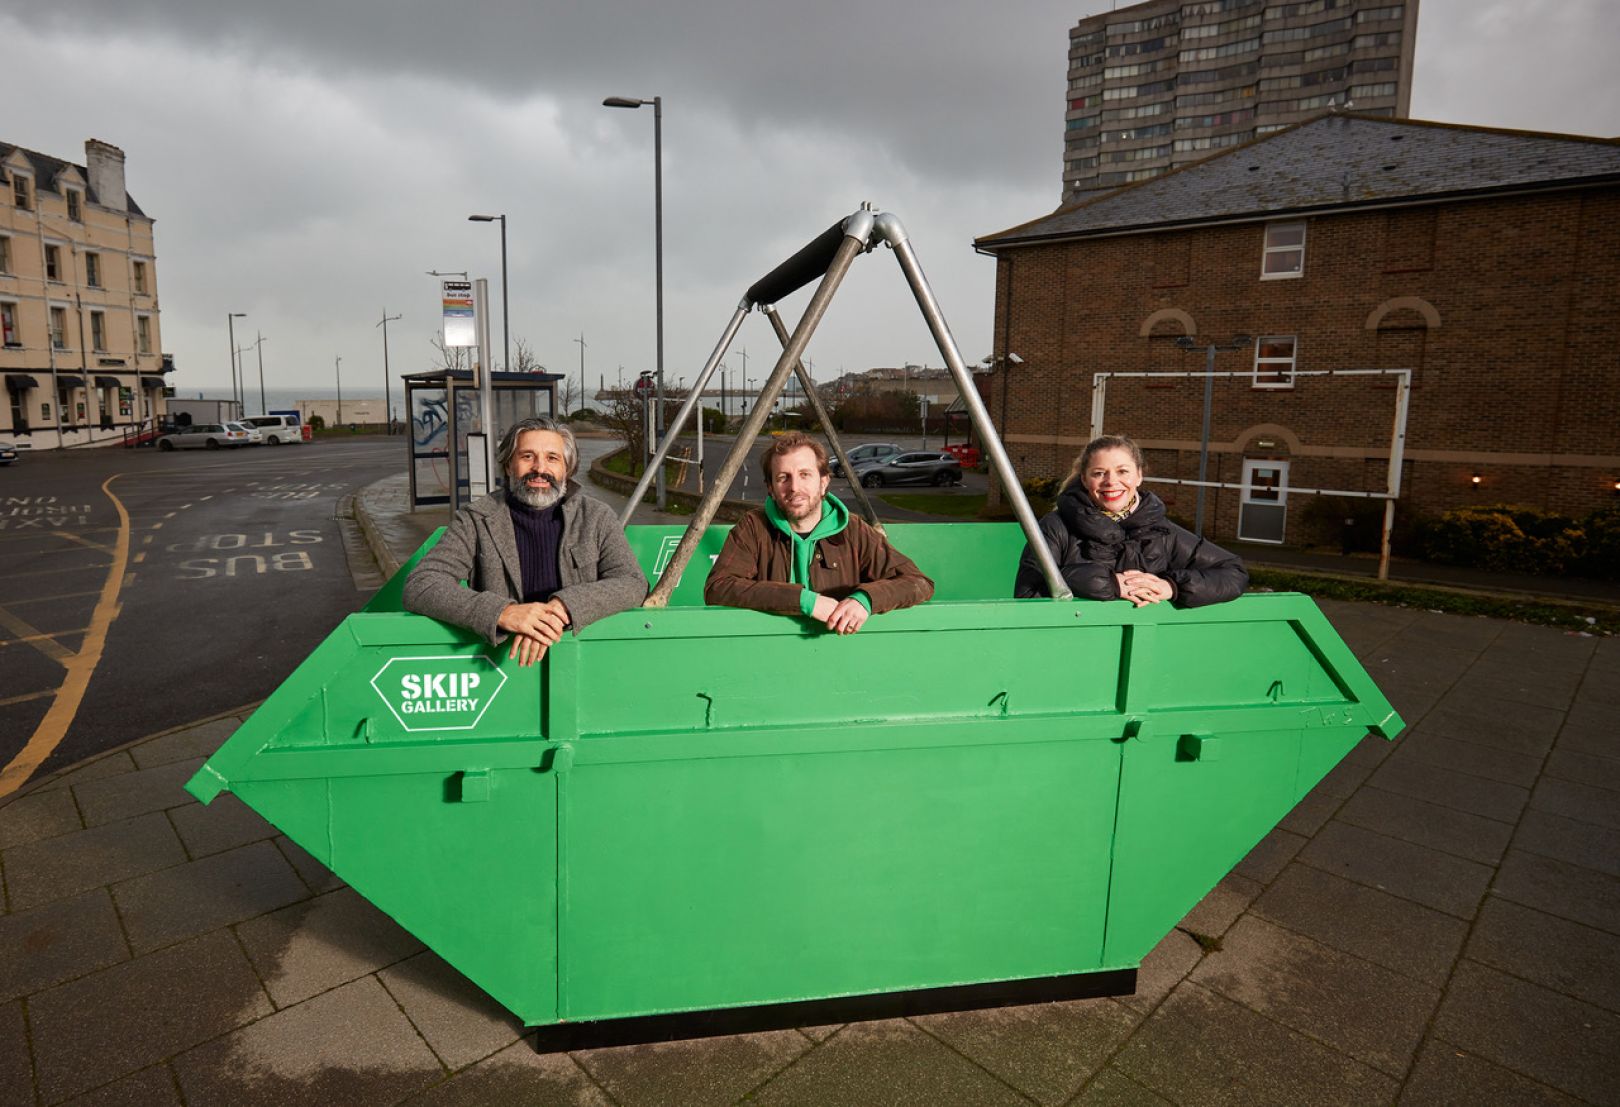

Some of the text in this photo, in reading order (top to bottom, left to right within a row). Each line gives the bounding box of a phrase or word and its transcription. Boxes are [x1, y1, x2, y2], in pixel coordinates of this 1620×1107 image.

[175, 551, 314, 580] BUS
[400, 672, 481, 700] SKIP
[400, 698, 480, 714] GALLERY
